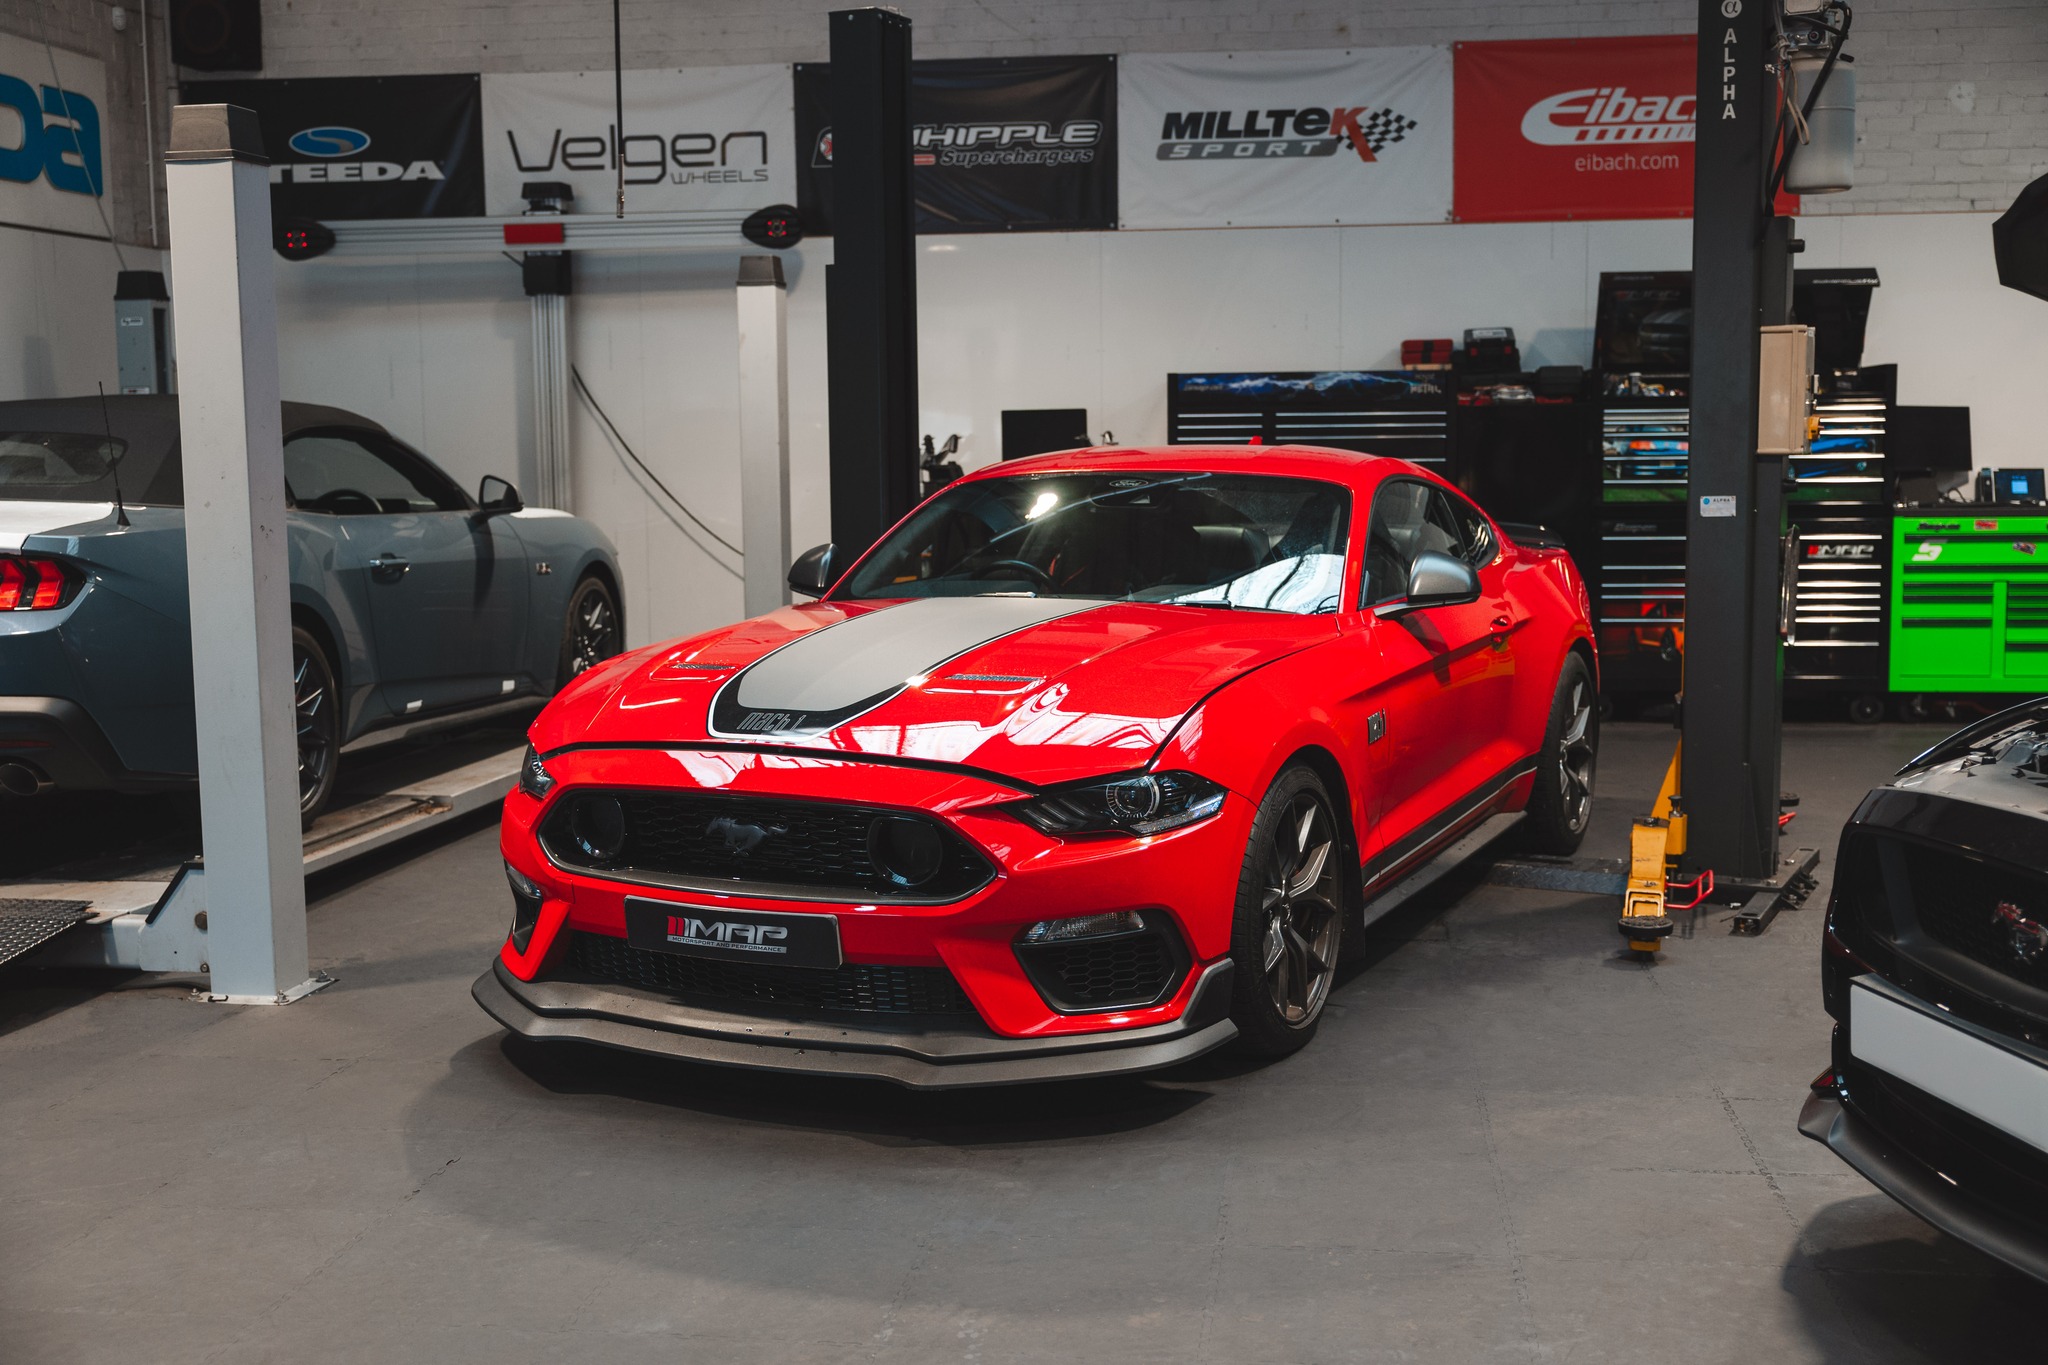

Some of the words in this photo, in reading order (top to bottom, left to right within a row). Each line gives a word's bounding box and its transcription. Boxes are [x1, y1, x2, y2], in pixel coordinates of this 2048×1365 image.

[1722, 28, 1737, 119] ALPHA
[1521, 87, 1697, 146] Eibac
[913, 121, 1101, 149] HIPPLE
[506, 124, 768, 185] Velgen
[940, 148, 1094, 167] Superchargers
[1169, 141, 1321, 158] SPORT
[270, 160, 446, 183] TEEDA
[1575, 153, 1679, 171] eibach.com
[670, 169, 769, 185] WHEELS
[672, 936, 714, 946] MOTORSPORT
[731, 943, 782, 952] PERFORMANCE
